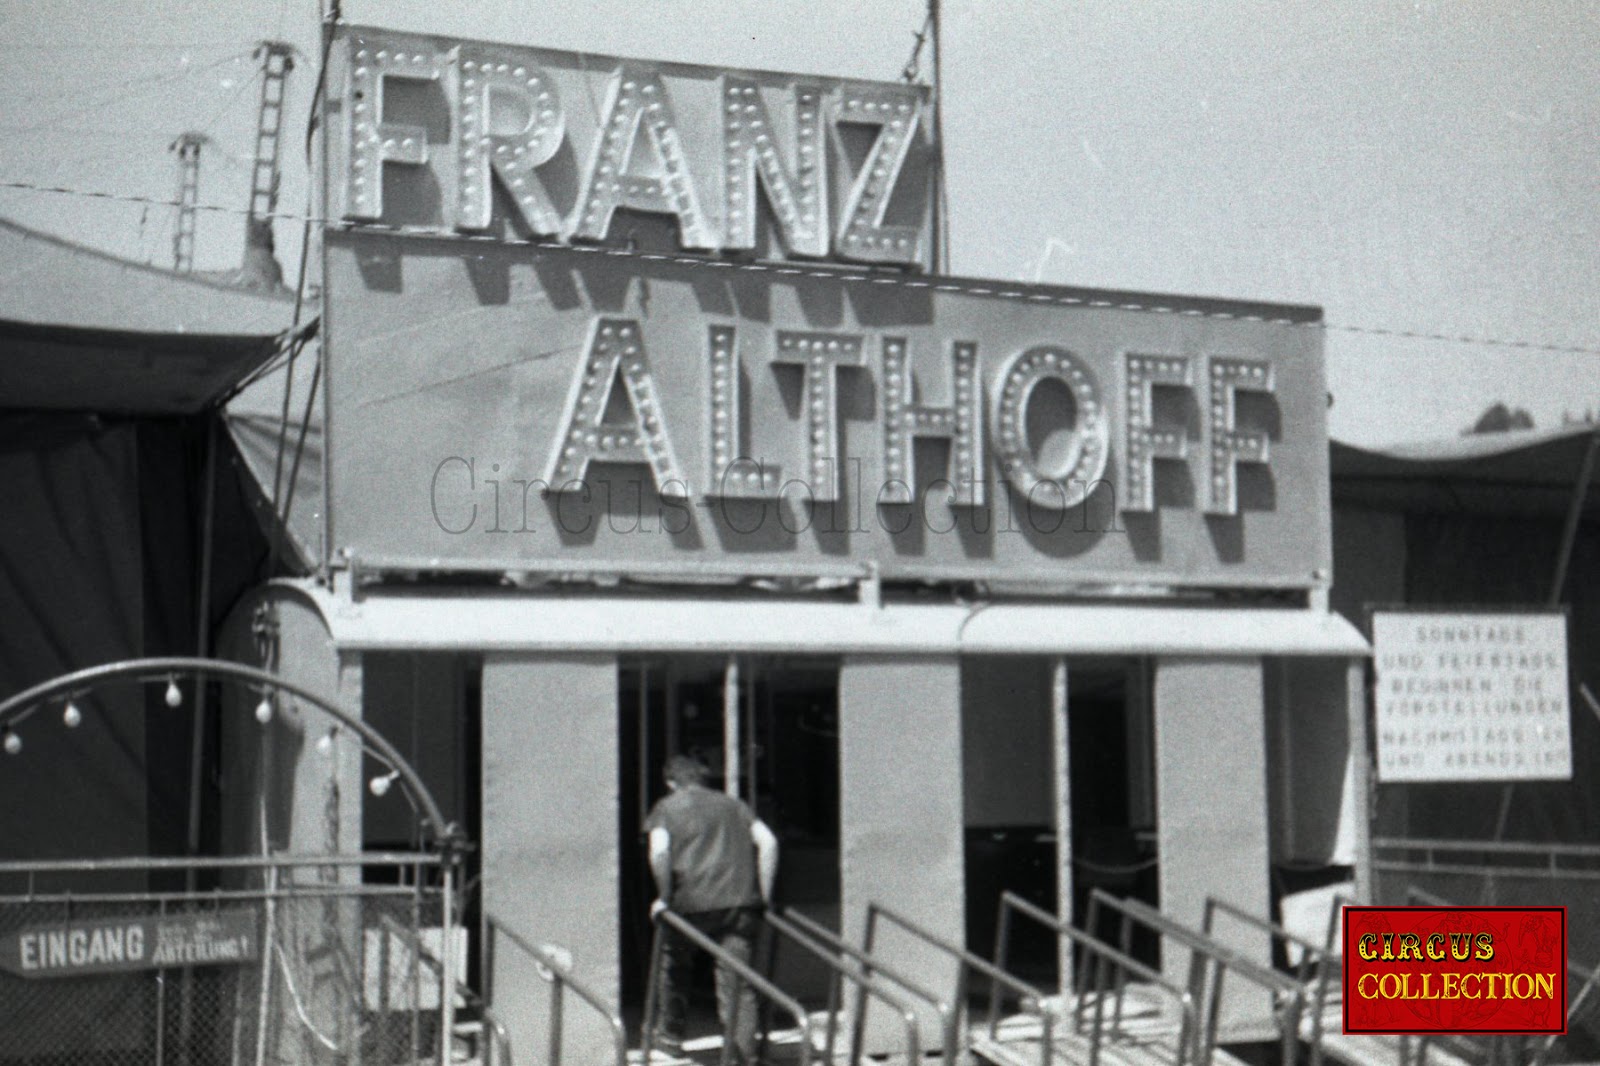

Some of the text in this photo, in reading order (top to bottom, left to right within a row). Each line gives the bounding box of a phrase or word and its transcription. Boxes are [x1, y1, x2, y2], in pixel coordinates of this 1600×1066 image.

[342, 38, 925, 266] FRANZ
[540, 314, 1274, 514] ALTHOFF
[20, 925, 144, 969] EINGANG
